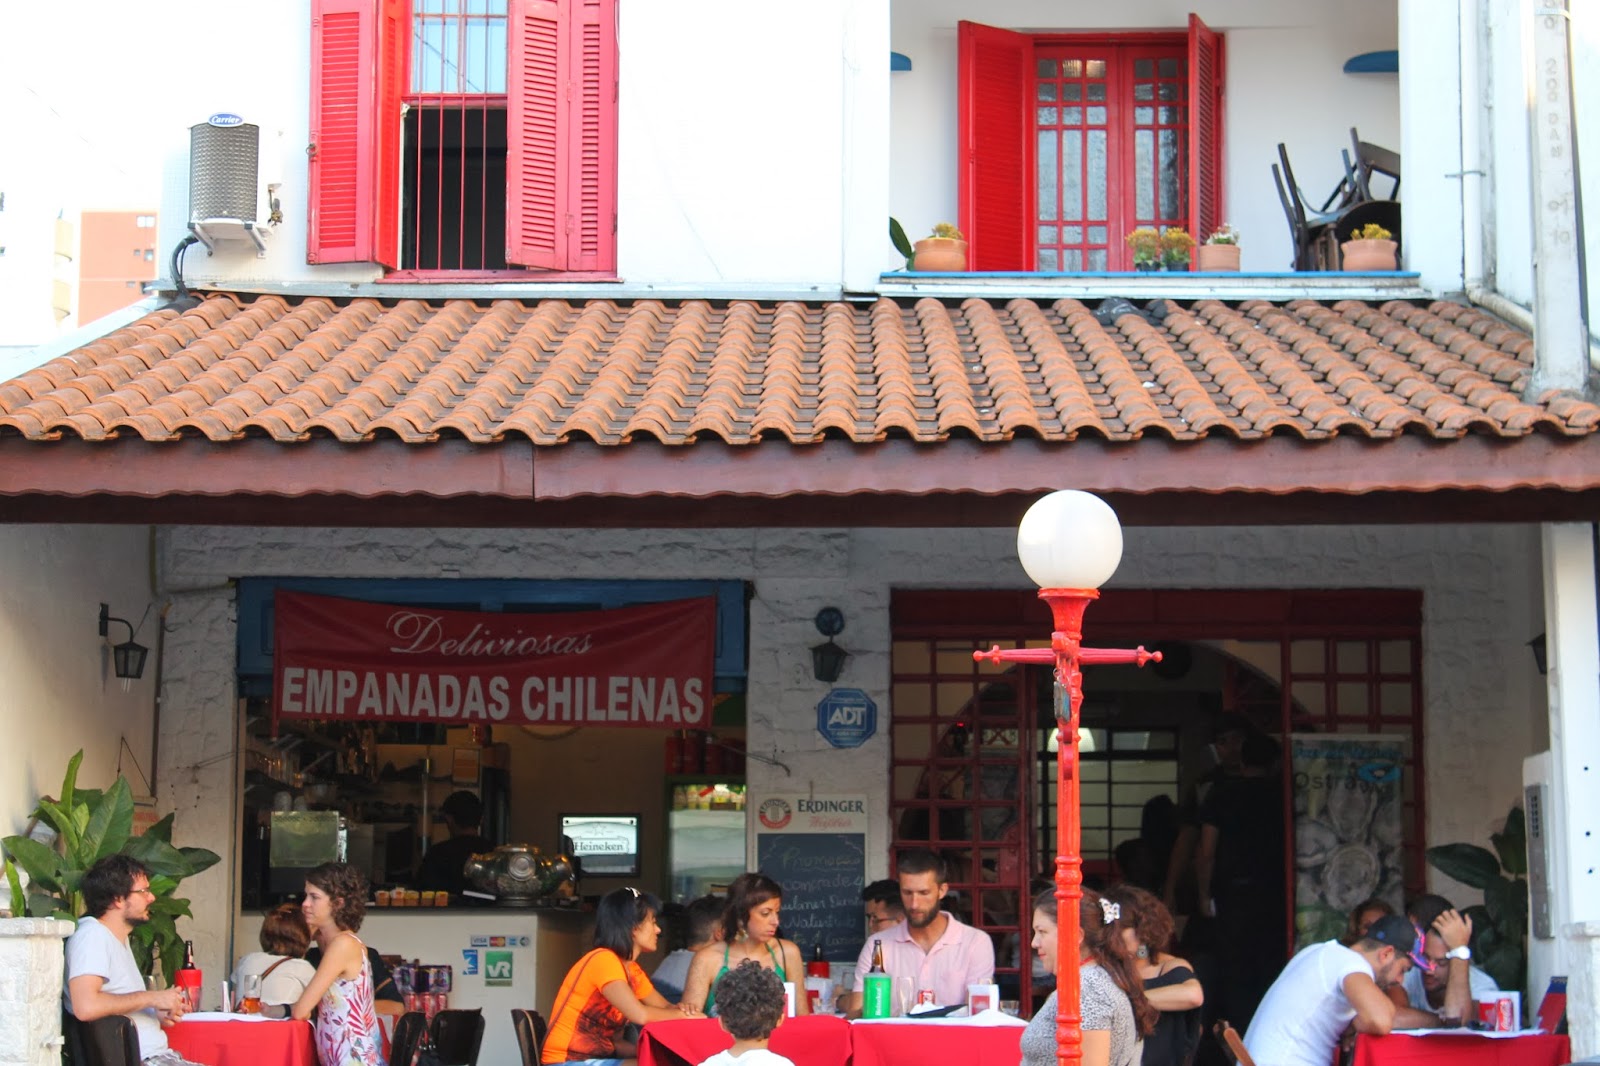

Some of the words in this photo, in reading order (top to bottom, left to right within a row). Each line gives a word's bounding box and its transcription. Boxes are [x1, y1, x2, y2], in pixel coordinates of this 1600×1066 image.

[211, 115, 240, 124] Carrier
[385, 610, 594, 657] Deliciosas
[281, 666, 511, 721] EMPANADAS
[521, 675, 705, 724] CHILENAS
[828, 706, 866, 726] ADT
[797, 799, 865, 814] ERDINGER
[574, 841, 624, 851] Heineken
